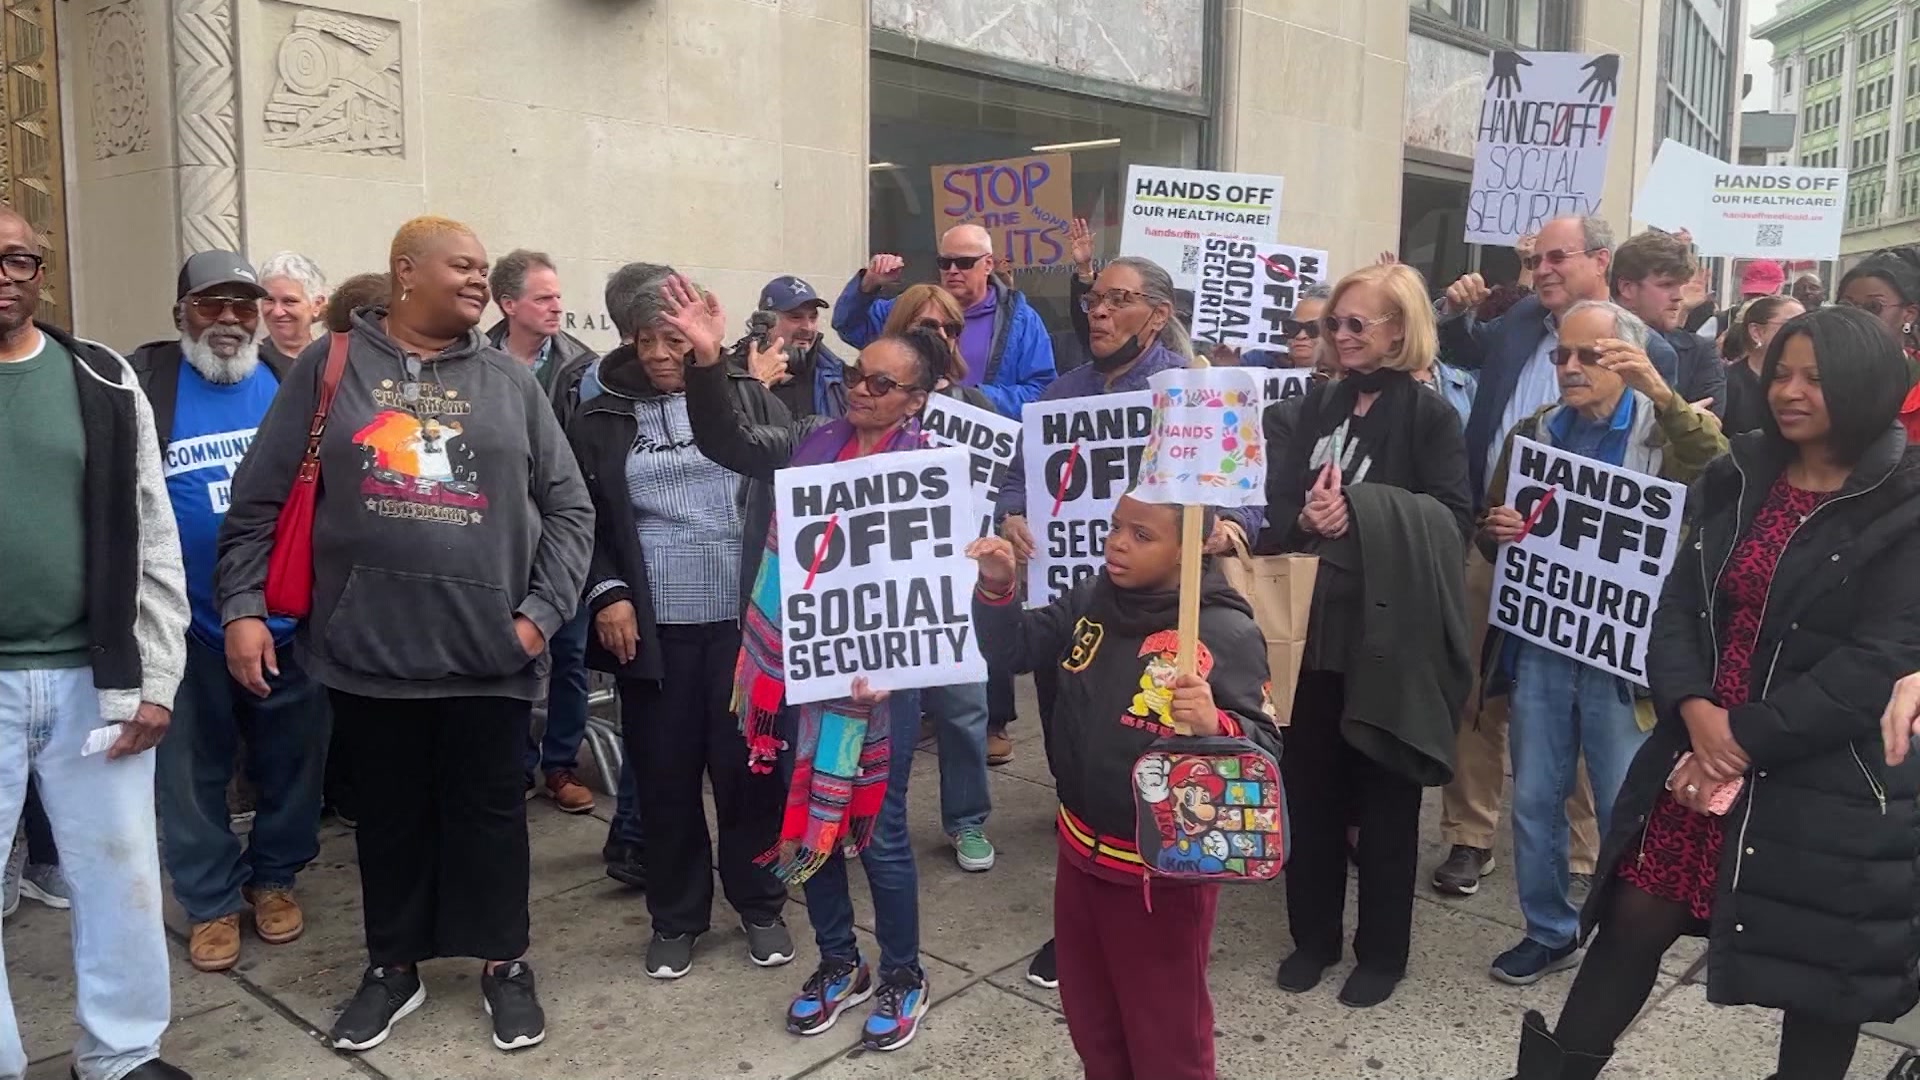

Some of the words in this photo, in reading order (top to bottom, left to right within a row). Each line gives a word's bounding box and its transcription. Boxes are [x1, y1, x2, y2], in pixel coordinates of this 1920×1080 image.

[1477, 99, 1554, 146] HANDS
[944, 162, 1050, 216] STOP
[1136, 178, 1221, 201] HANDS
[1226, 185, 1275, 204] OFF
[1486, 146, 1585, 194] SOCIAL
[1715, 174, 1791, 189] HANDS
[1796, 176, 1840, 191] OFF
[983, 211, 1021, 228] THE
[1132, 204, 1164, 217] OUR
[1167, 208, 1270, 225] HEALTHCARE!
[1712, 194, 1741, 204] OUR
[1743, 195, 1837, 207] HEALTHCARE!
[1198, 238, 1227, 343] SECURITY
[1220, 242, 1257, 343] SOCIAL
[566, 312, 611, 330] RAL
[923, 409, 1014, 458] ANDS
[1042, 406, 1152, 444] HAND
[166, 434, 257, 468] COMMUNI
[1169, 445, 1198, 459] OFF
[792, 466, 949, 517] HANDS
[1520, 447, 1673, 520] HANDS
[794, 504, 953, 575] OFF!
[1515, 485, 1667, 576] OFF!
[787, 575, 969, 642] SOCIAL
[1504, 546, 1650, 629] SEGURO
[789, 625, 968, 681] SECURITY
[1497, 585, 1642, 676] SOCIAL
